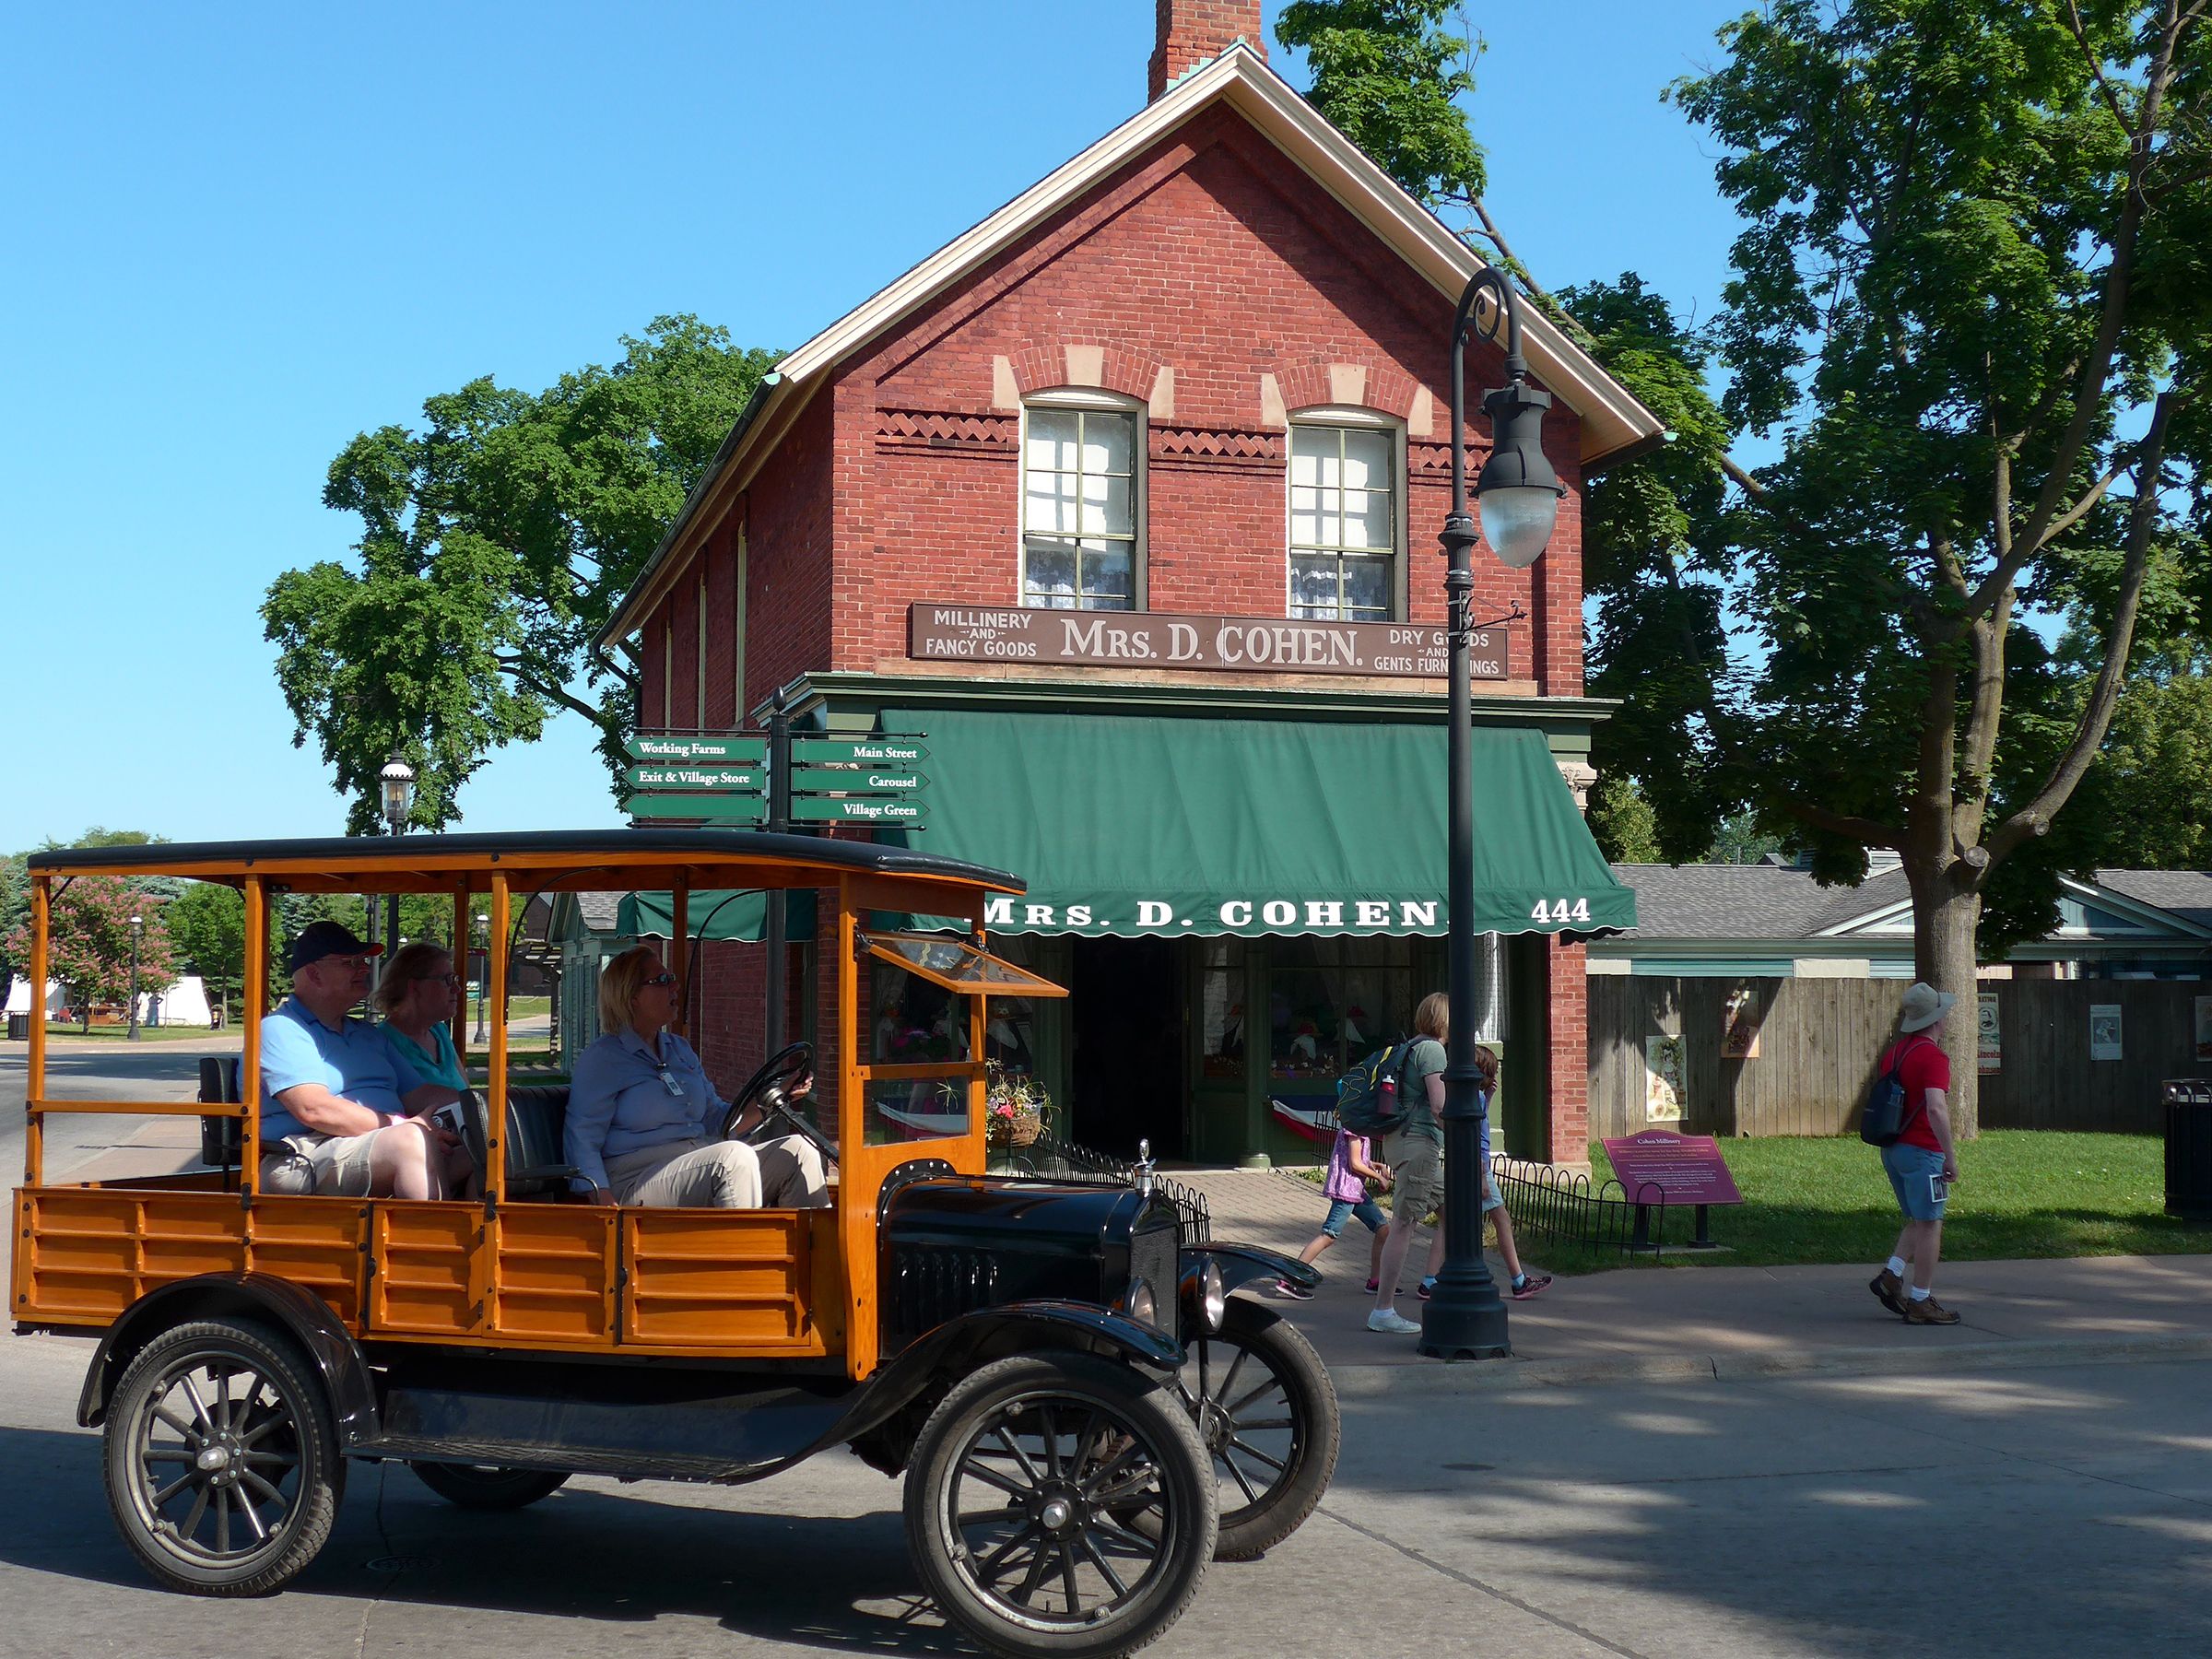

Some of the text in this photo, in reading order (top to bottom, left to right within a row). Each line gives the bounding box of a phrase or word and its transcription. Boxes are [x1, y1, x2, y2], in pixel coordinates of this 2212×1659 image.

[934, 609, 1032, 629] MILLINERY
[969, 628, 996, 640] AND
[1389, 629, 1489, 648] DRY GDS
[925, 638, 1037, 657] FANCY GOODS
[1167, 623, 1204, 661] D.
[1216, 626, 1363, 666] COHEN.
[1426, 647, 1449, 657] AND
[1374, 656, 1500, 675] GENTS FURNINGS
[639, 742, 726, 757] Working Farms
[853, 746, 917, 759] Main Street
[638, 771, 750, 786] Exit & Village Store
[868, 775, 917, 787] Carousel
[842, 803, 918, 818] Village Green
[1135, 900, 1194, 927] D.
[1219, 900, 1450, 927] COHEN
[1531, 898, 1591, 924] 444
